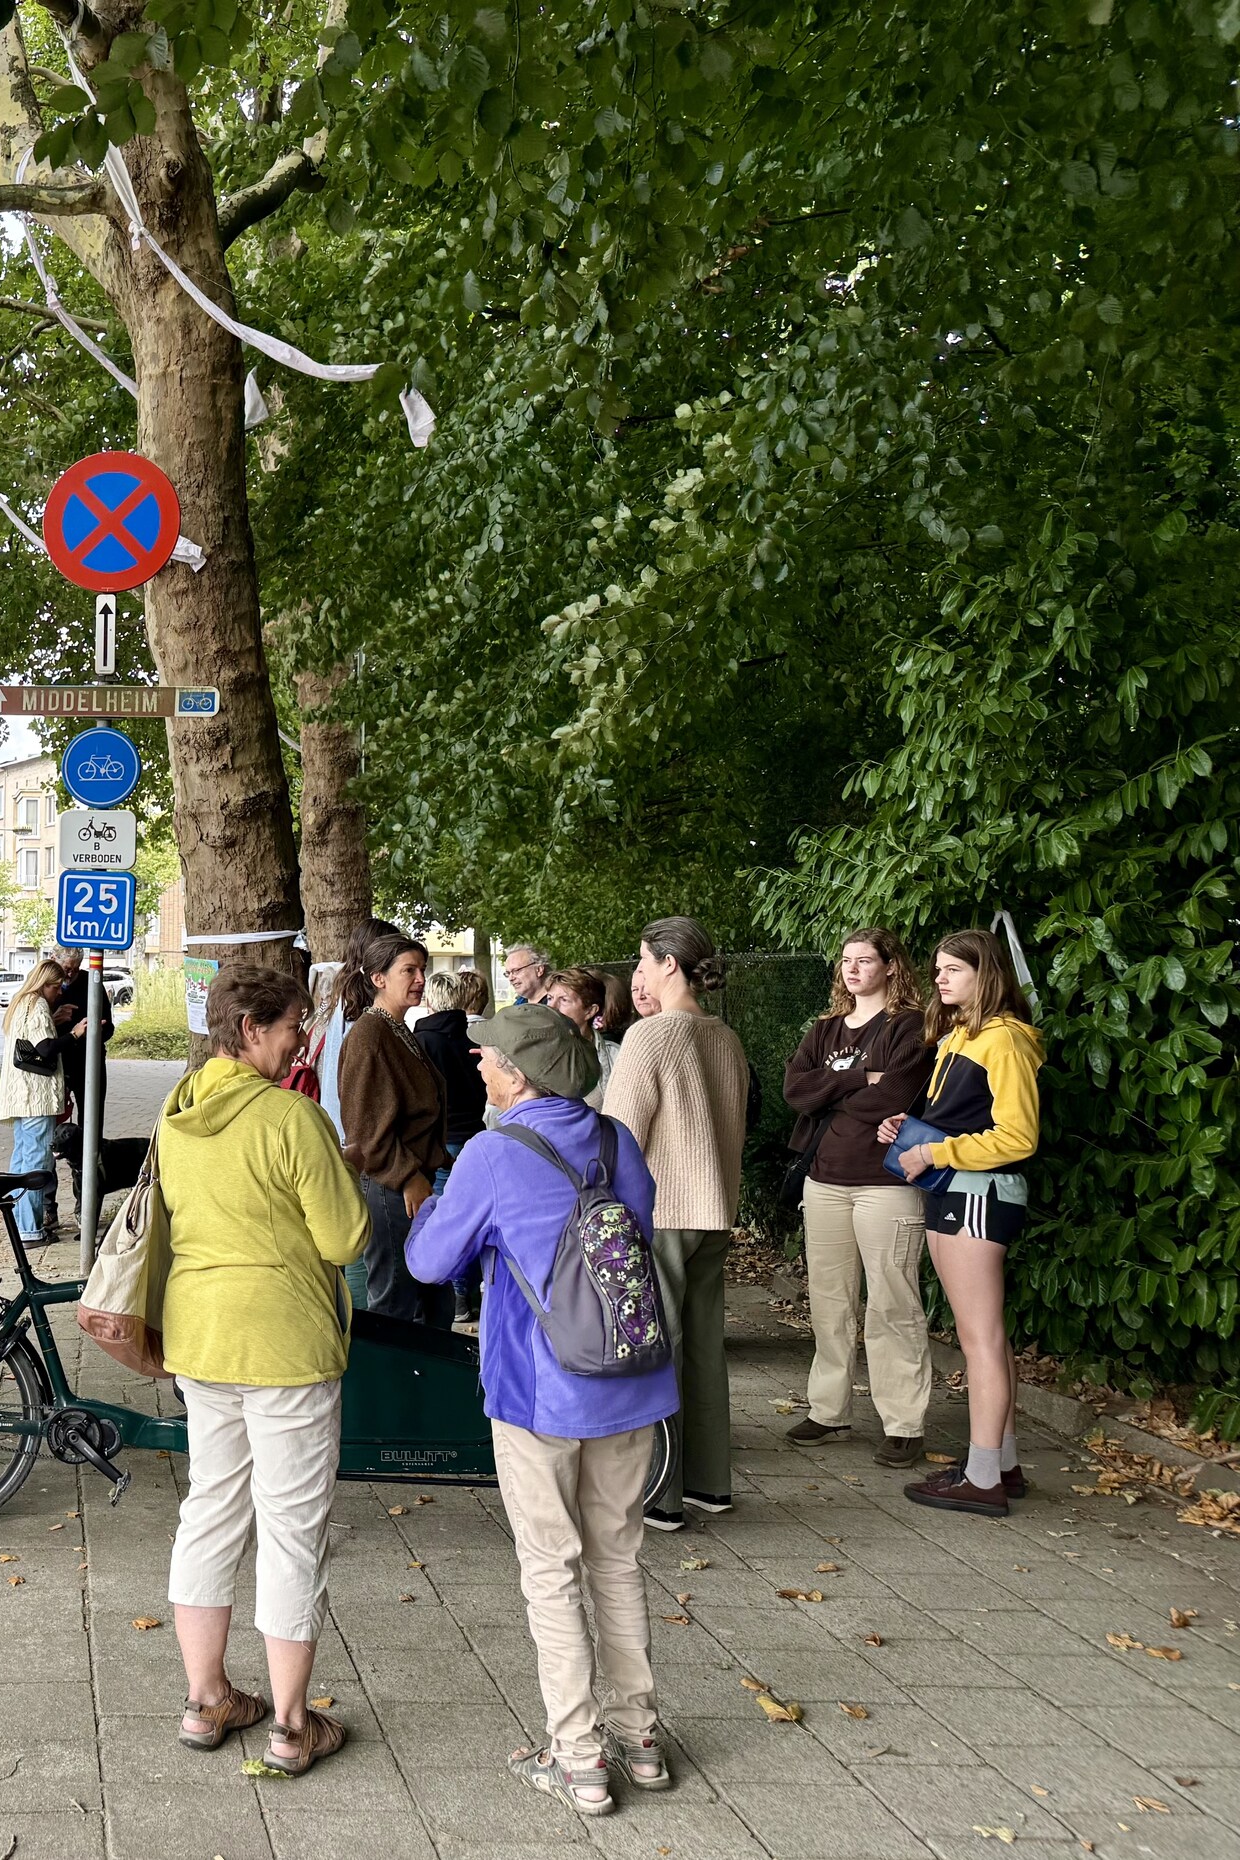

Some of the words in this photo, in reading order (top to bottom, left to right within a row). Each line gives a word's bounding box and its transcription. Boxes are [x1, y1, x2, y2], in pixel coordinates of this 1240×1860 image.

[22, 689, 158, 713] MIDDELHEIM
[93, 841, 101, 851] B
[72, 853, 122, 864] VERBODEN
[73, 881, 119, 915] 25
[66, 915, 123, 939] km/u
